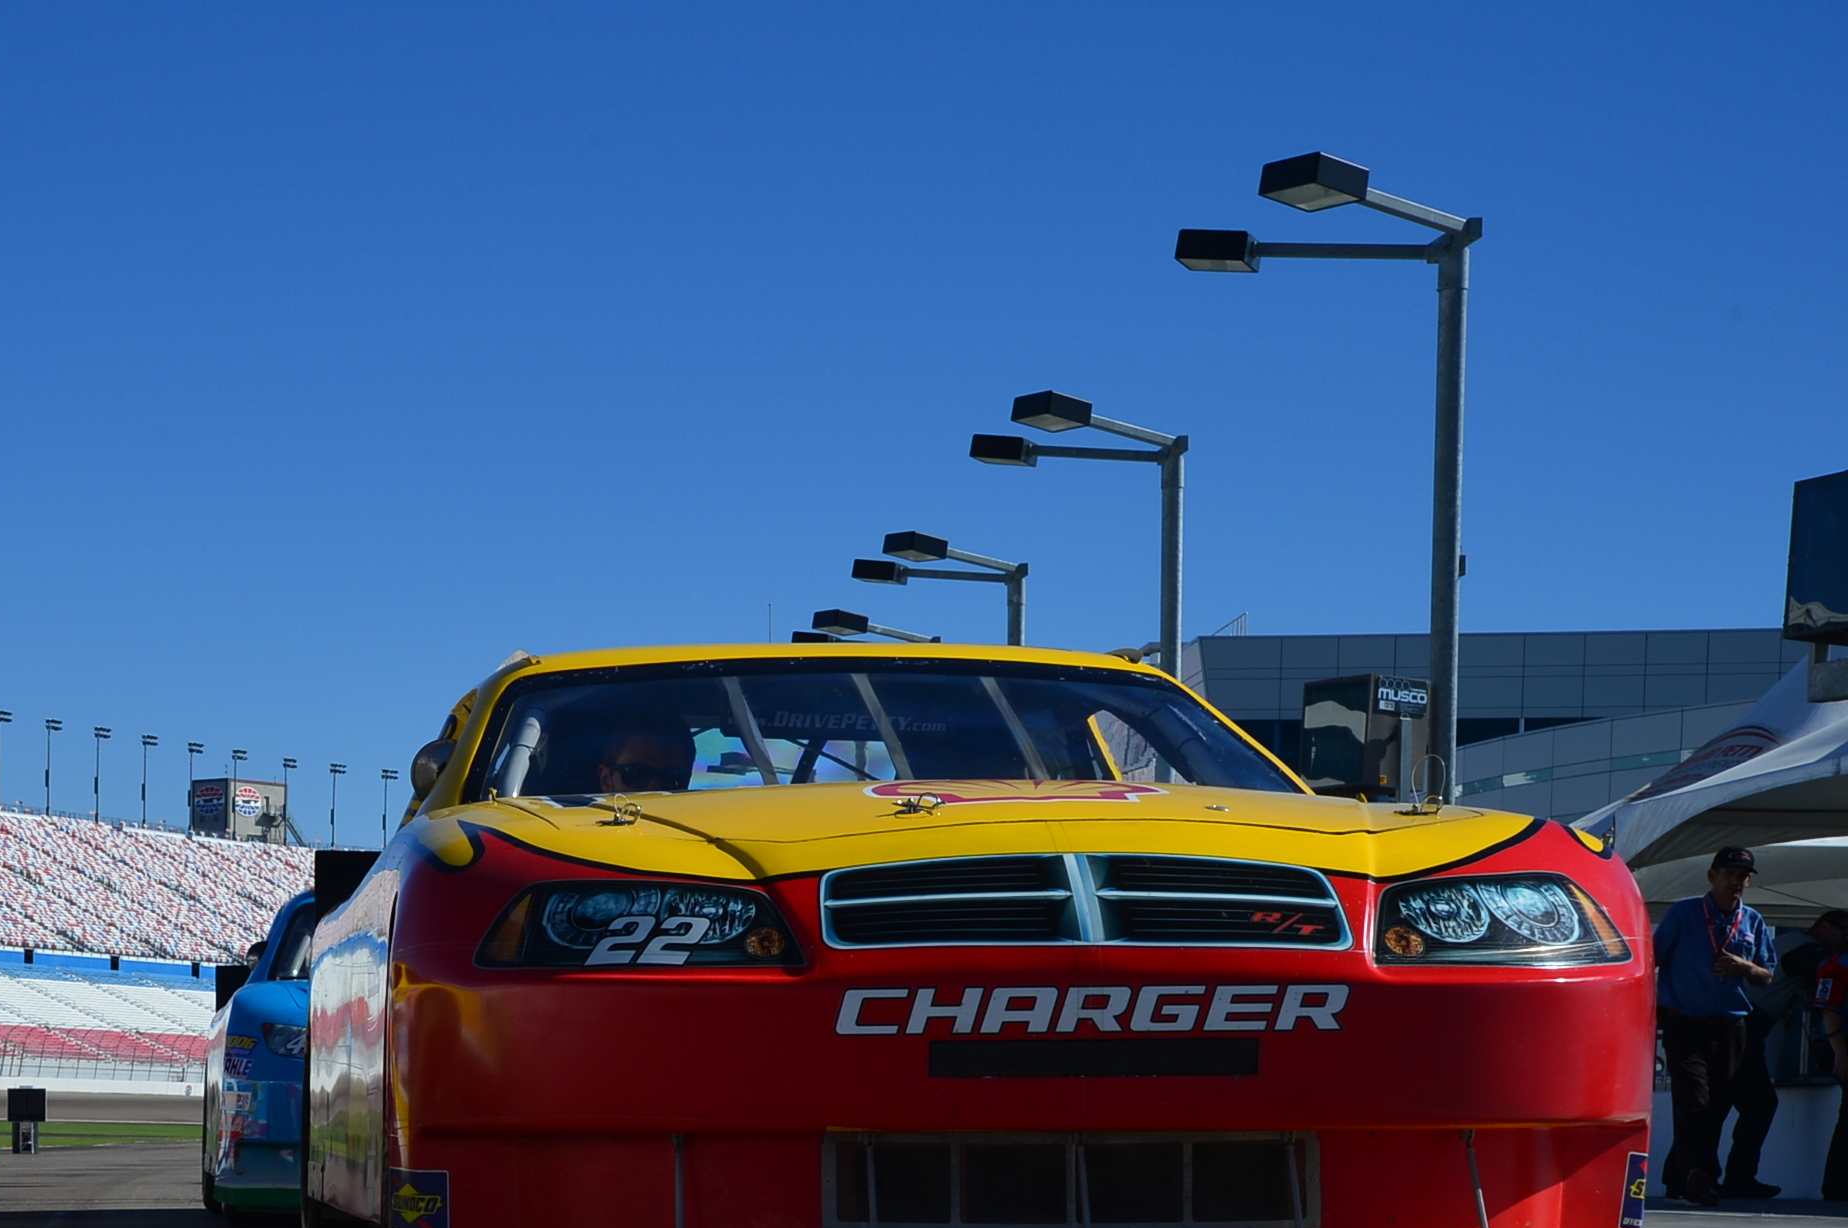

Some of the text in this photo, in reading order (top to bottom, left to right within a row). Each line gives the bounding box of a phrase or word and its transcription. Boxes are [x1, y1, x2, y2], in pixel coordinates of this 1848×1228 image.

[1250, 911, 1326, 936] R/T
[583, 914, 711, 967] 22
[834, 983, 1351, 1036] CHARGER
[223, 1058, 253, 1077] AHLE
[392, 1194, 439, 1213] SUNOCO
